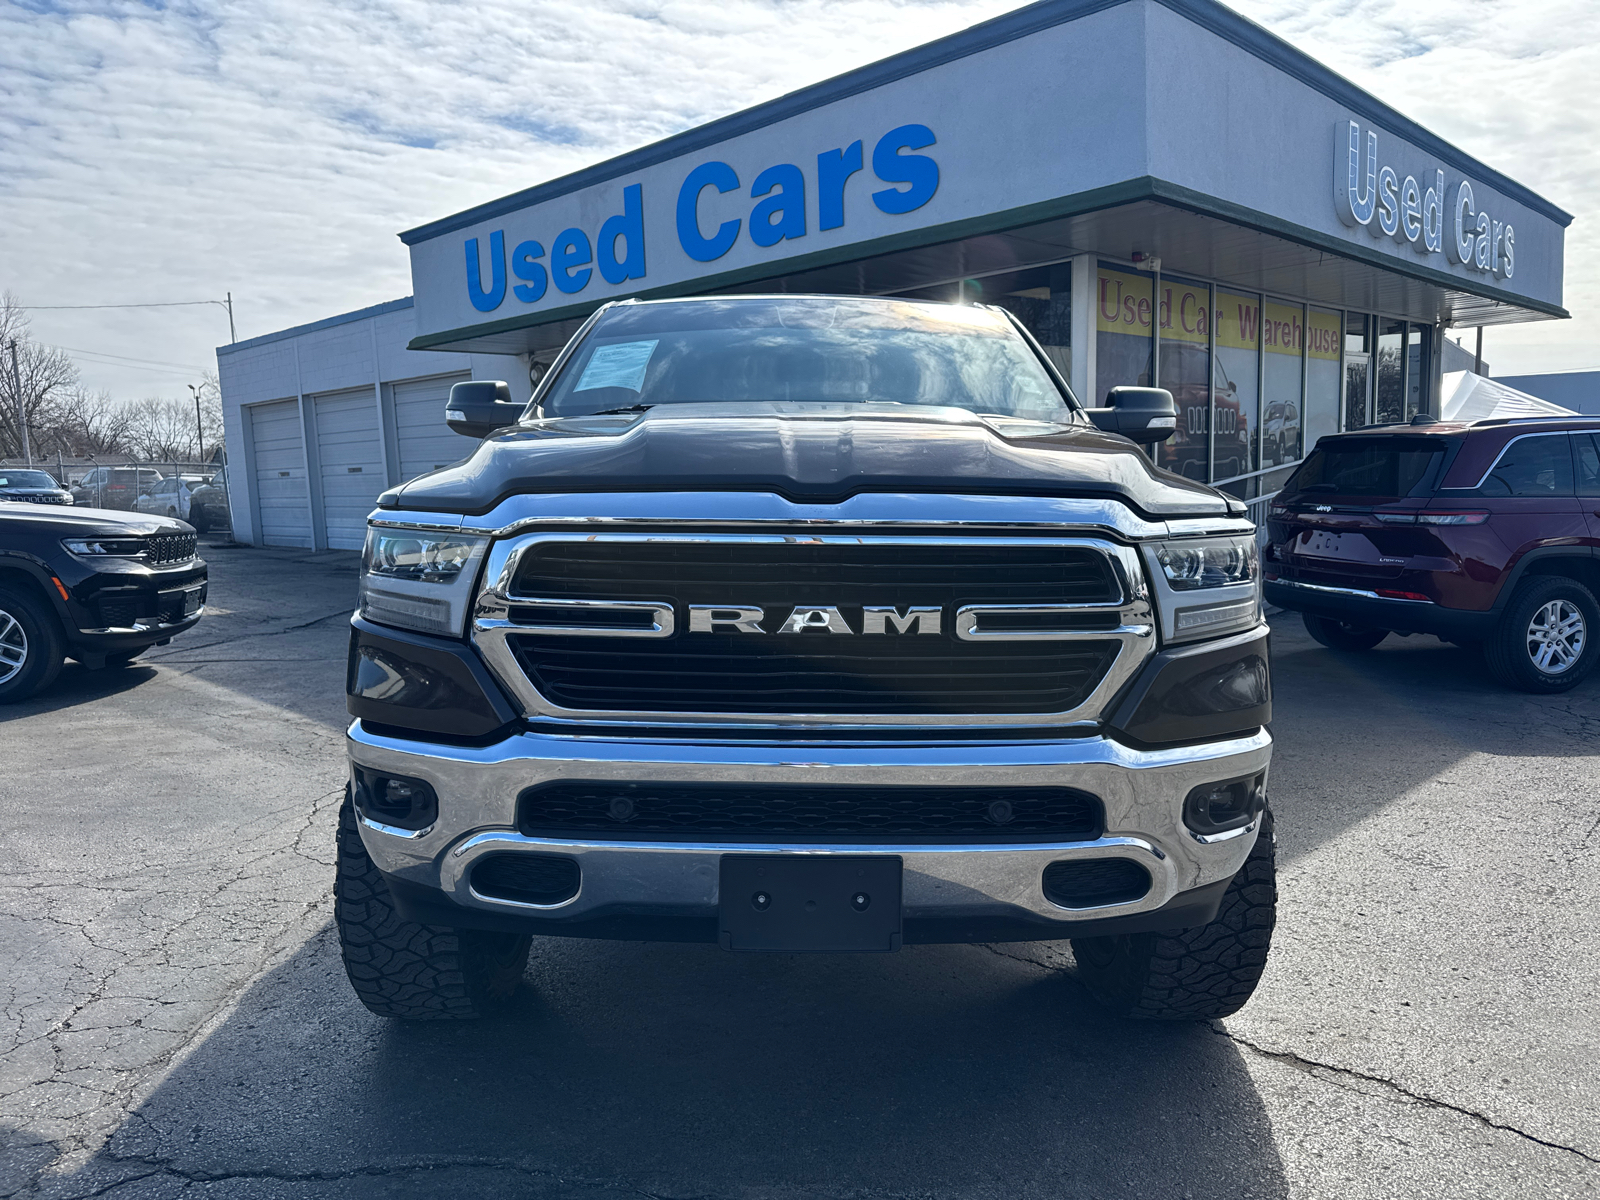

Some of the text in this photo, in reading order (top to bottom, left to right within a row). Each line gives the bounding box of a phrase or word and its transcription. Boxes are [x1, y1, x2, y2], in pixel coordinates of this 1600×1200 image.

[464, 123, 940, 312] Used Cars
[1347, 120, 1515, 279] Used Cars
[1099, 276, 1339, 354] Used Car Warehouse
[688, 604, 943, 635] RAM
